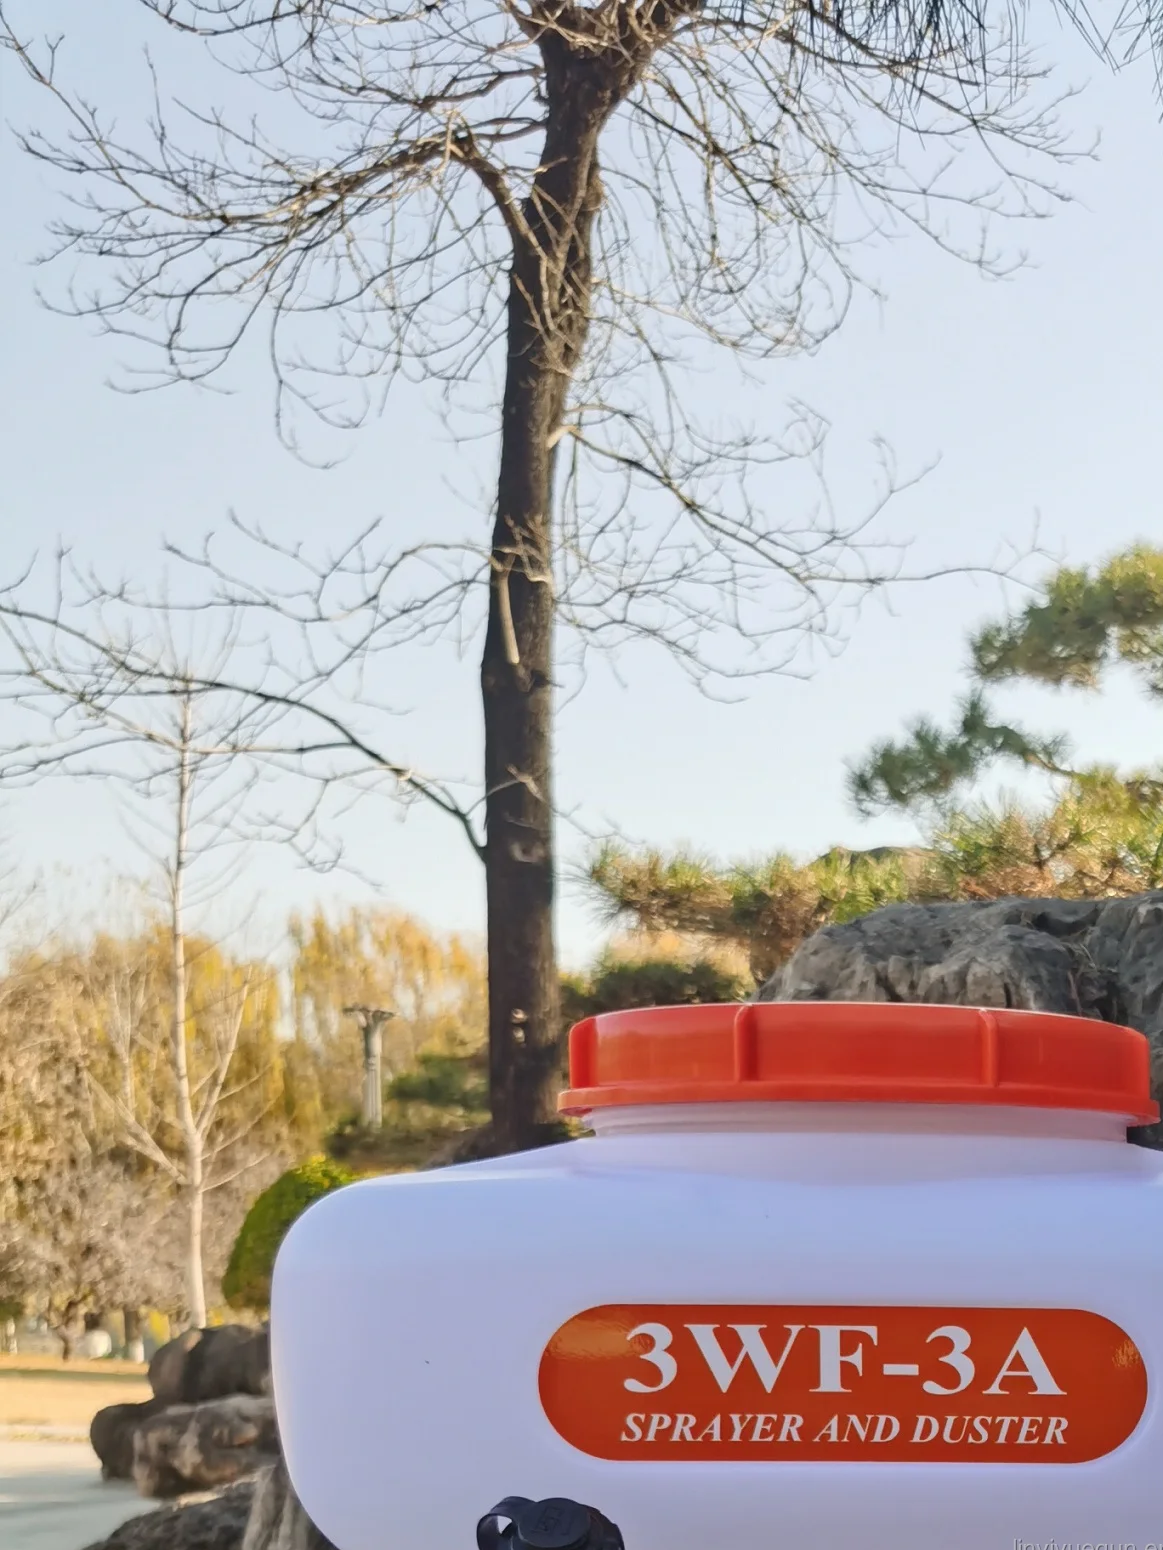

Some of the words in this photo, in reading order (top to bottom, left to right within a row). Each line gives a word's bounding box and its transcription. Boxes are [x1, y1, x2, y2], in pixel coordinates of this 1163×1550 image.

[624, 1323, 1067, 1395] 3WF-3A
[621, 1414, 803, 1441] SPRAYER
[814, 1415, 899, 1442] AND
[911, 1416, 1068, 1443] DUSTER
